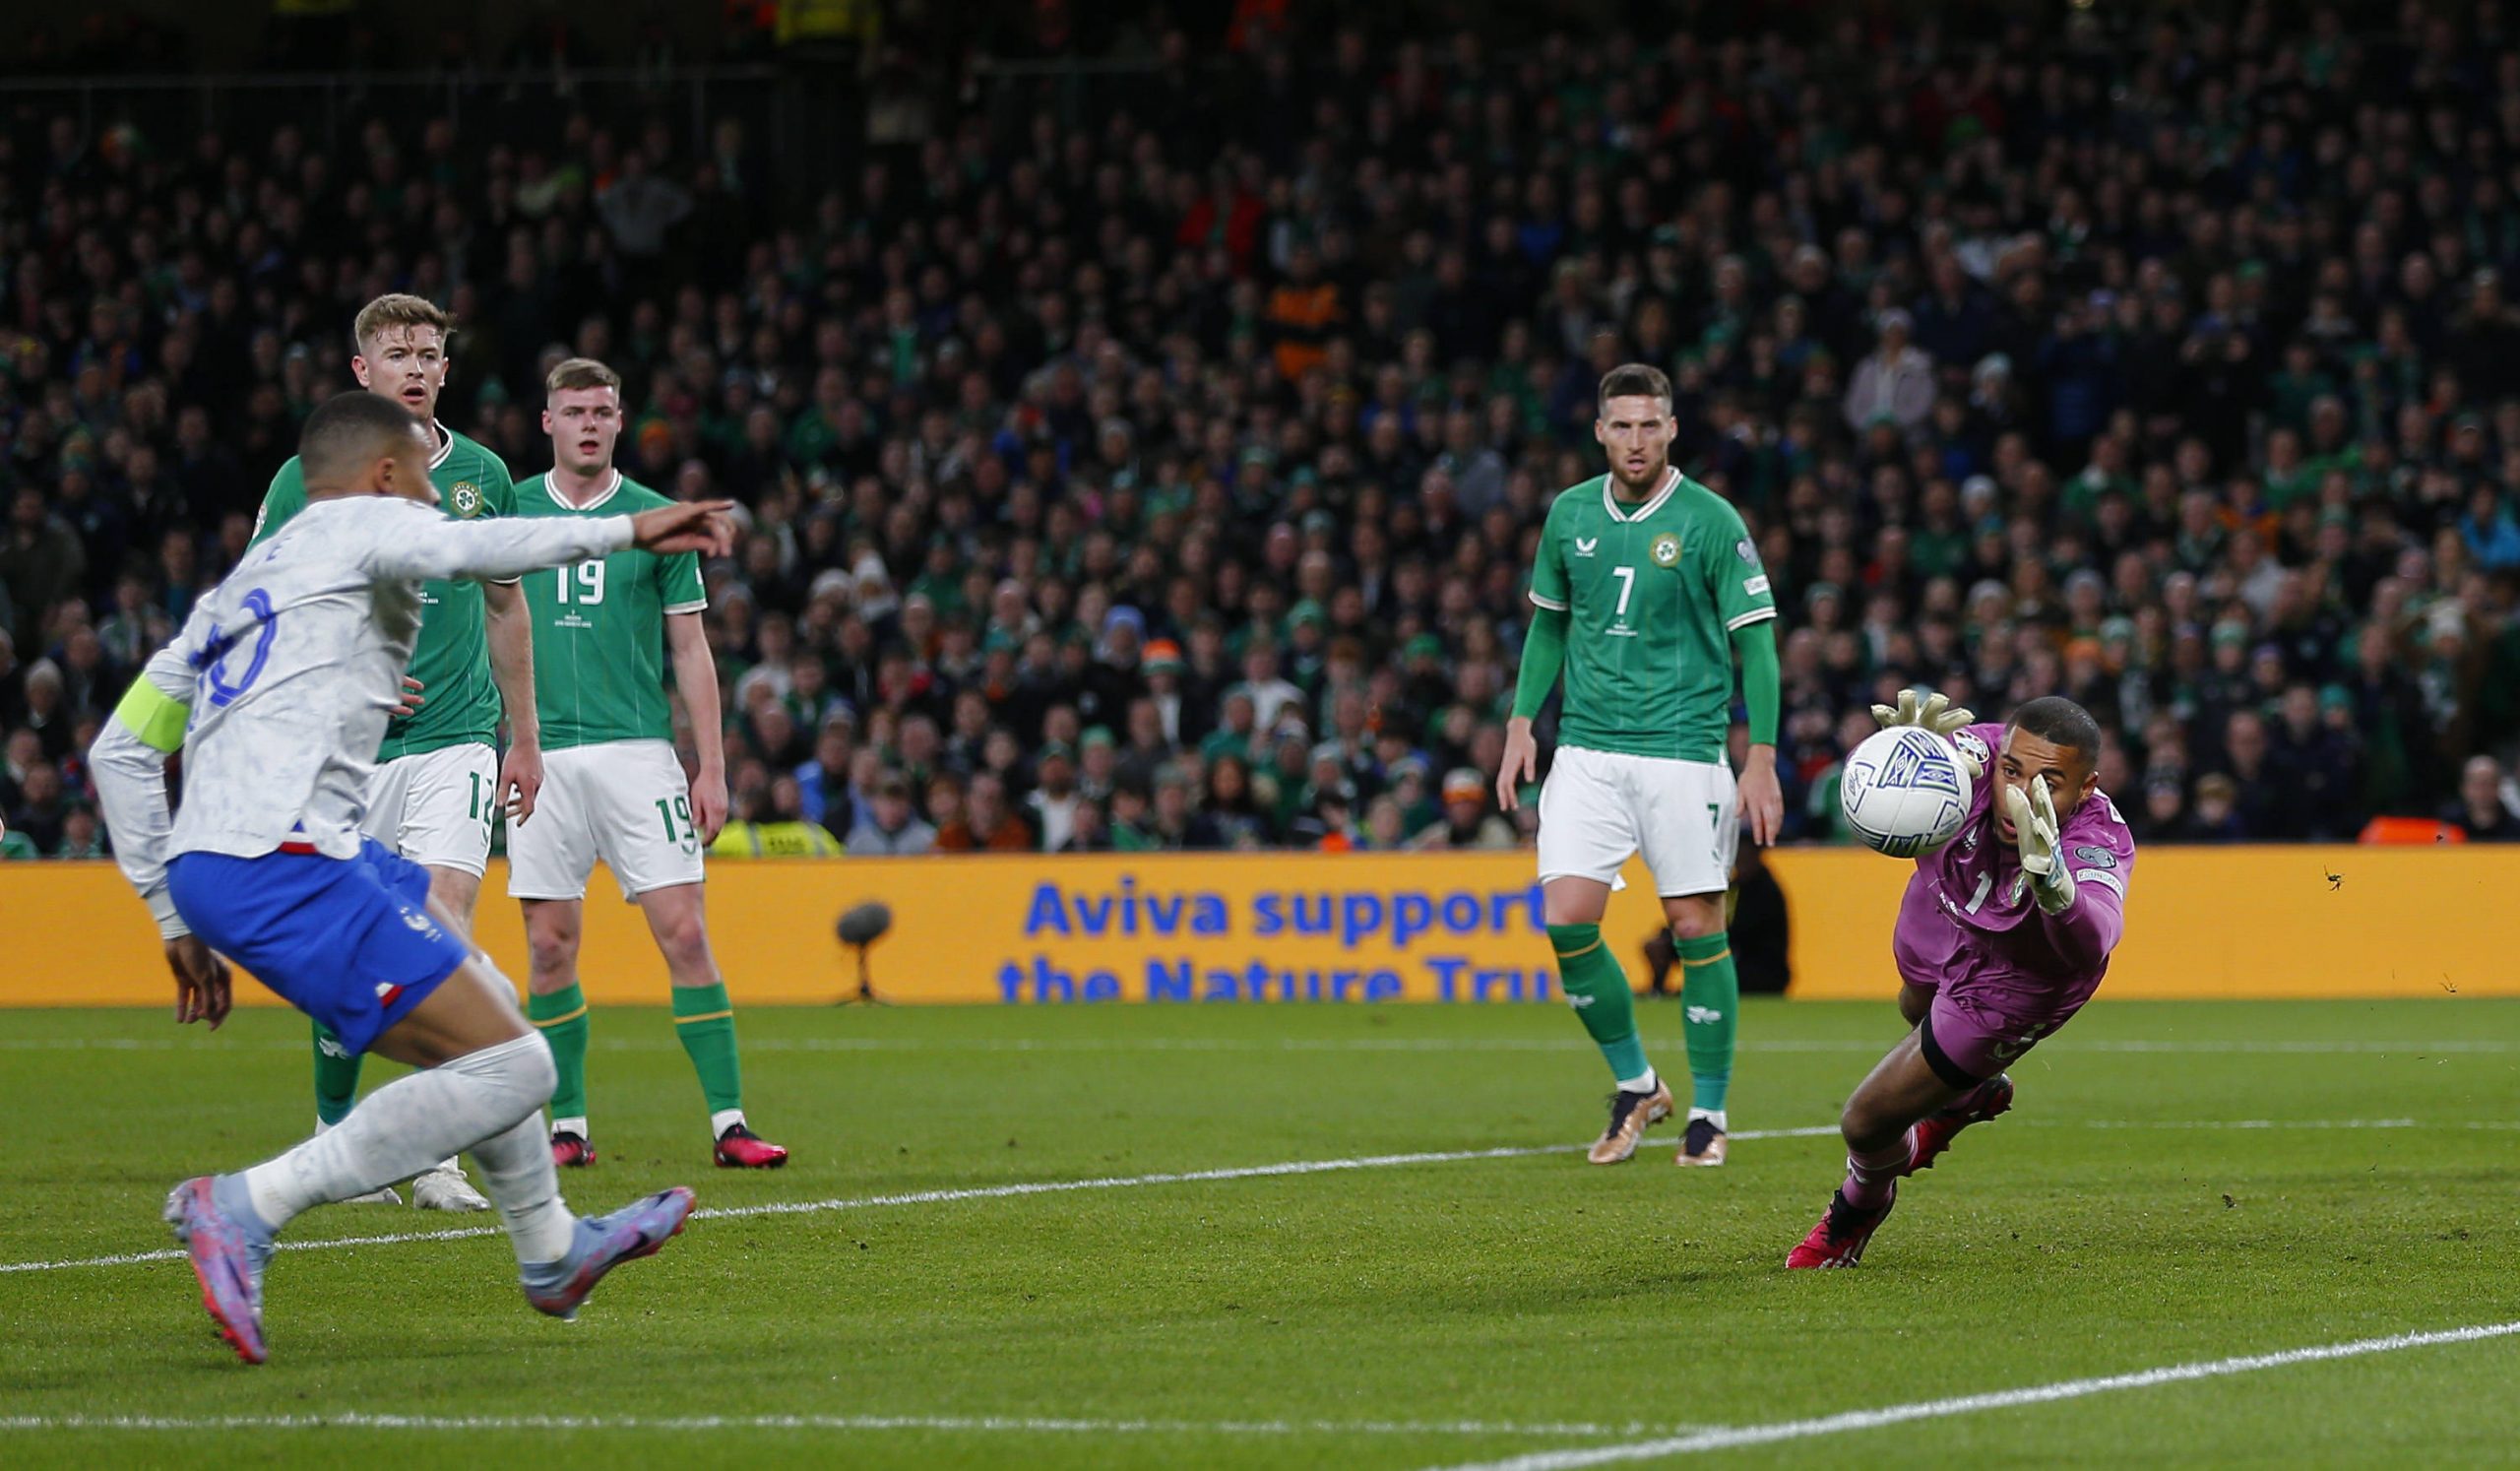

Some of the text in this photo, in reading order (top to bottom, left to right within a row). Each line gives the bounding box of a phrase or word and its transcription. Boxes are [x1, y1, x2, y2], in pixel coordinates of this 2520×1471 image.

[557, 559, 605, 605] 19
[1612, 566, 1635, 615] 7
[655, 796, 694, 843] 19
[1707, 802, 1719, 830] 7
[1025, 876, 1546, 948] Aviva support
[1965, 870, 1992, 916] 1
[997, 957, 1550, 1003] the Nature Tru
